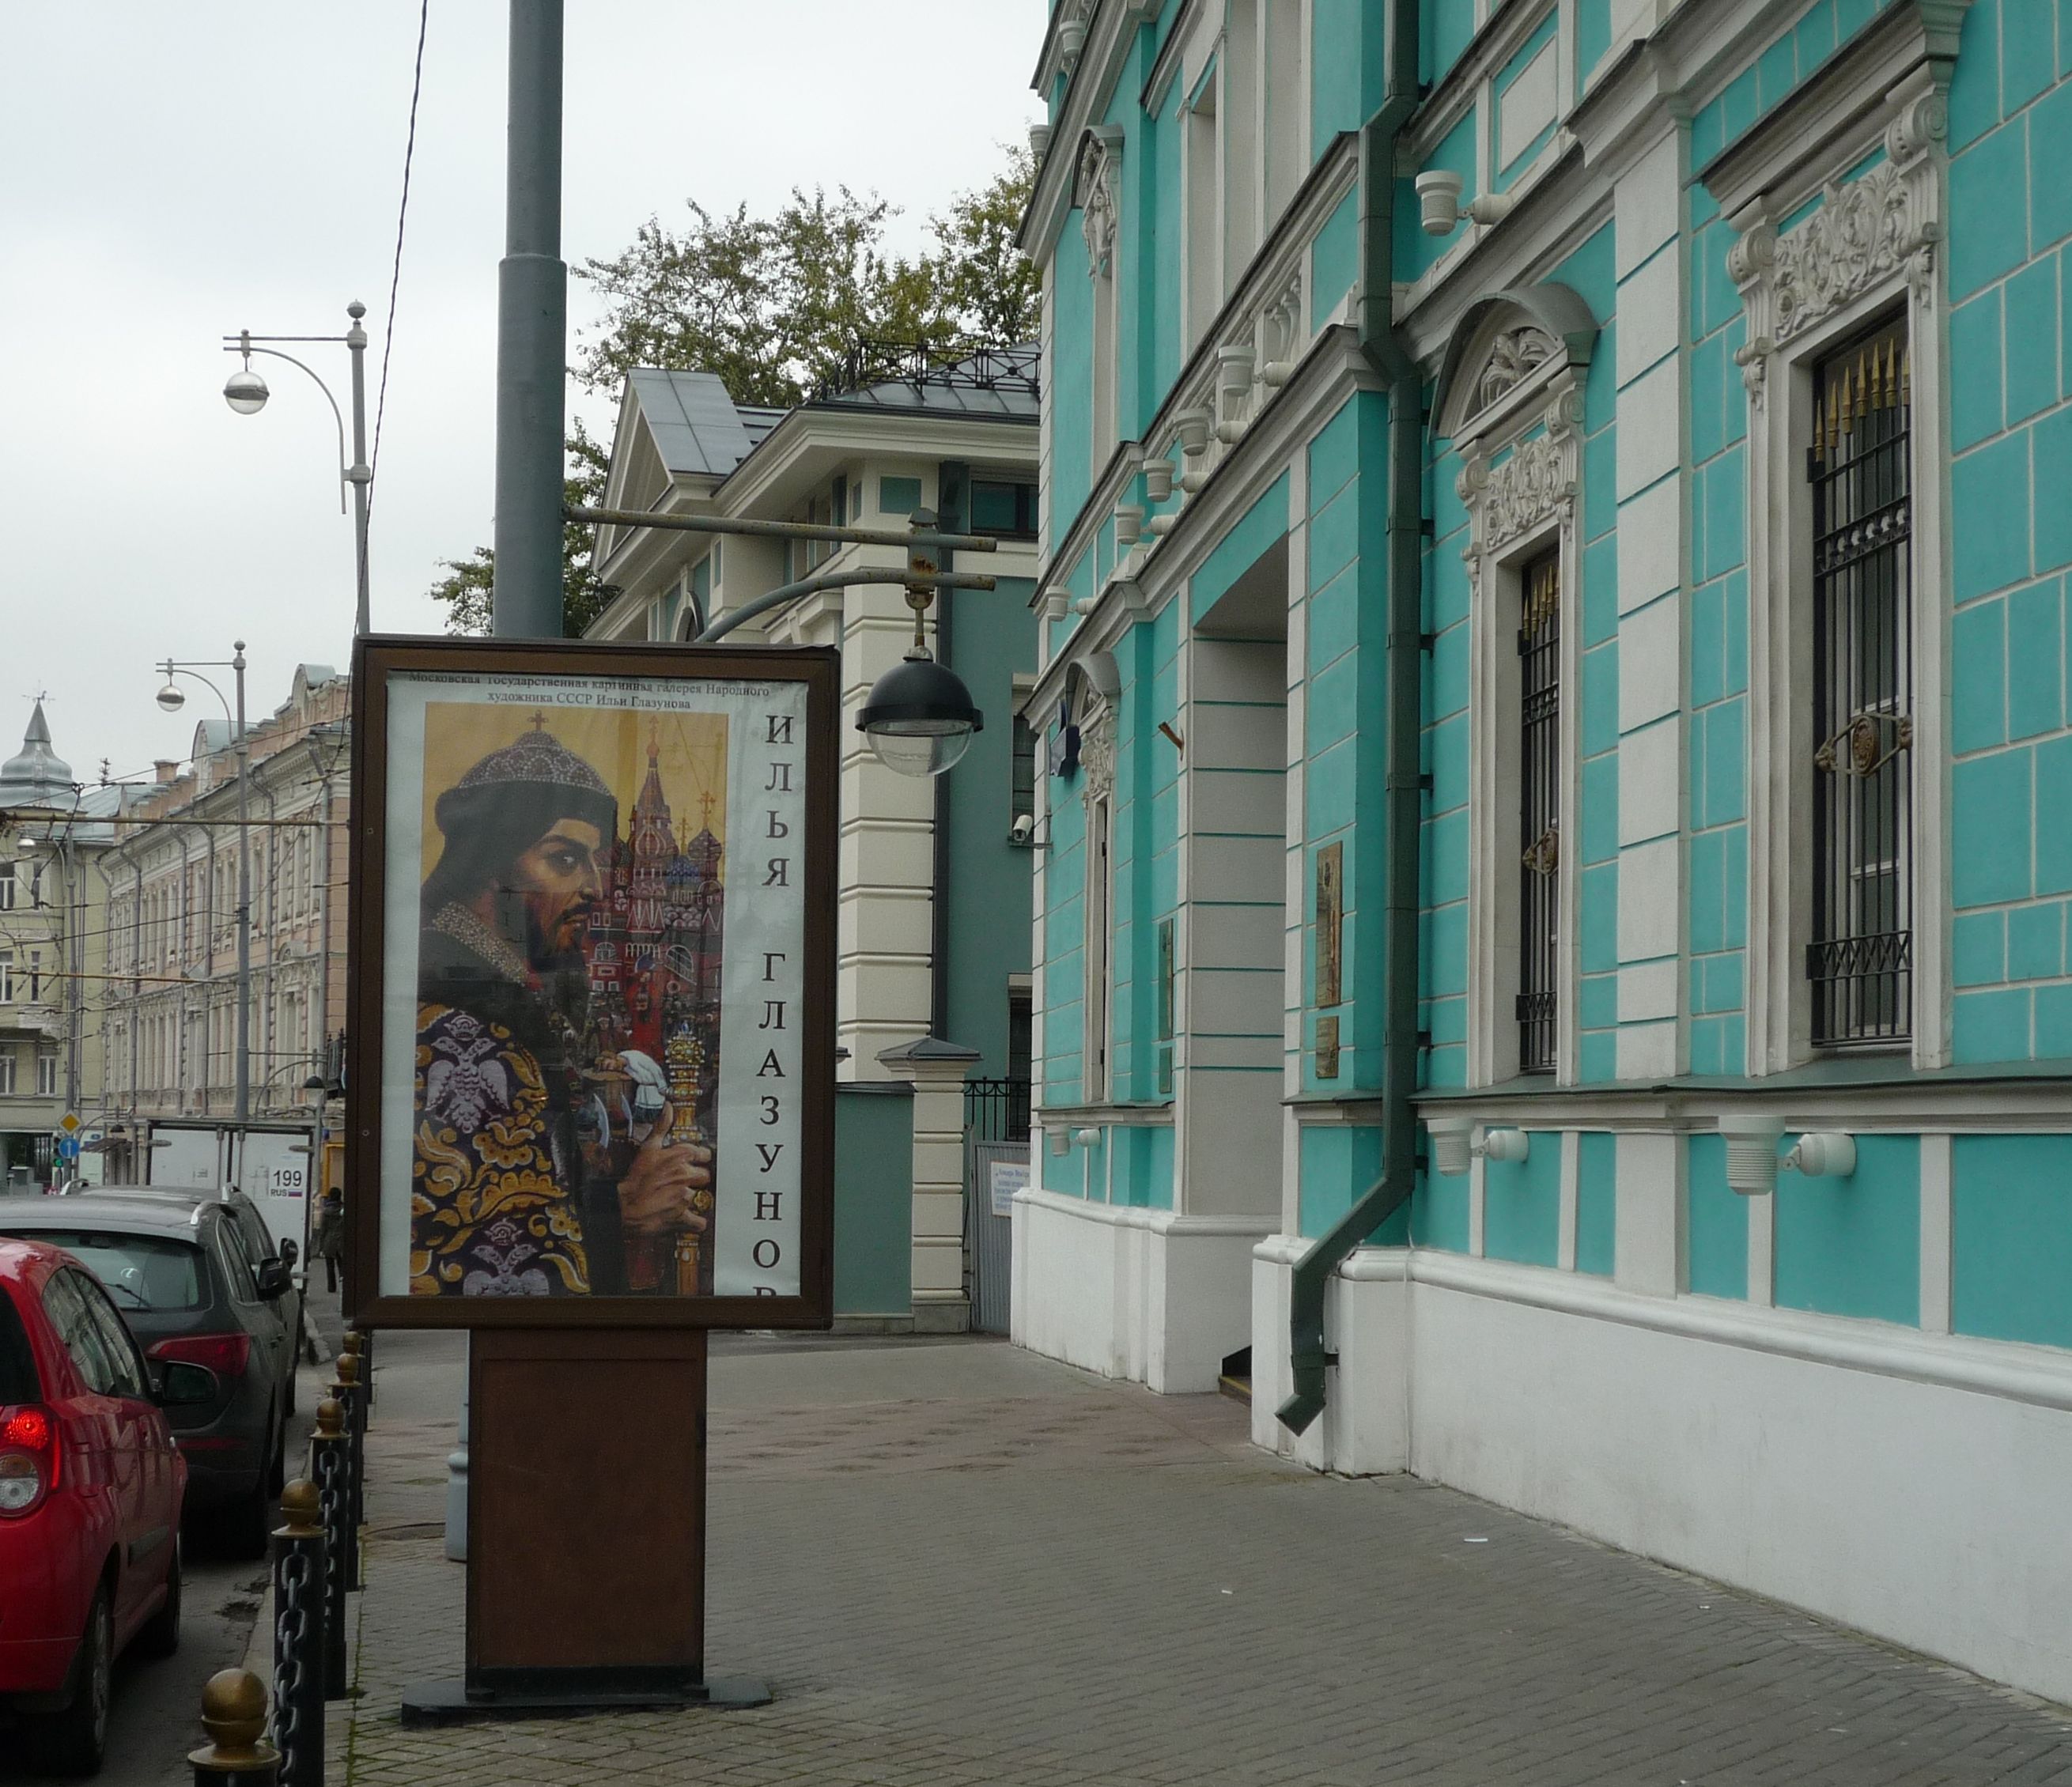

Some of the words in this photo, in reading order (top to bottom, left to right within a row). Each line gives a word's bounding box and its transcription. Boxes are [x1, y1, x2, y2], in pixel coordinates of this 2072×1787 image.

[592, 680, 652, 693] картинная
[656, 683, 701, 696] галерея
[705, 681, 769, 697] Народного
[487, 691, 553, 704] художника
[557, 692, 592, 705] СССР
[596, 693, 627, 706] Ильи
[631, 696, 690, 710] Глазунова
[273, 1169, 302, 1187] 199
[270, 1188, 287, 1197] RUS
